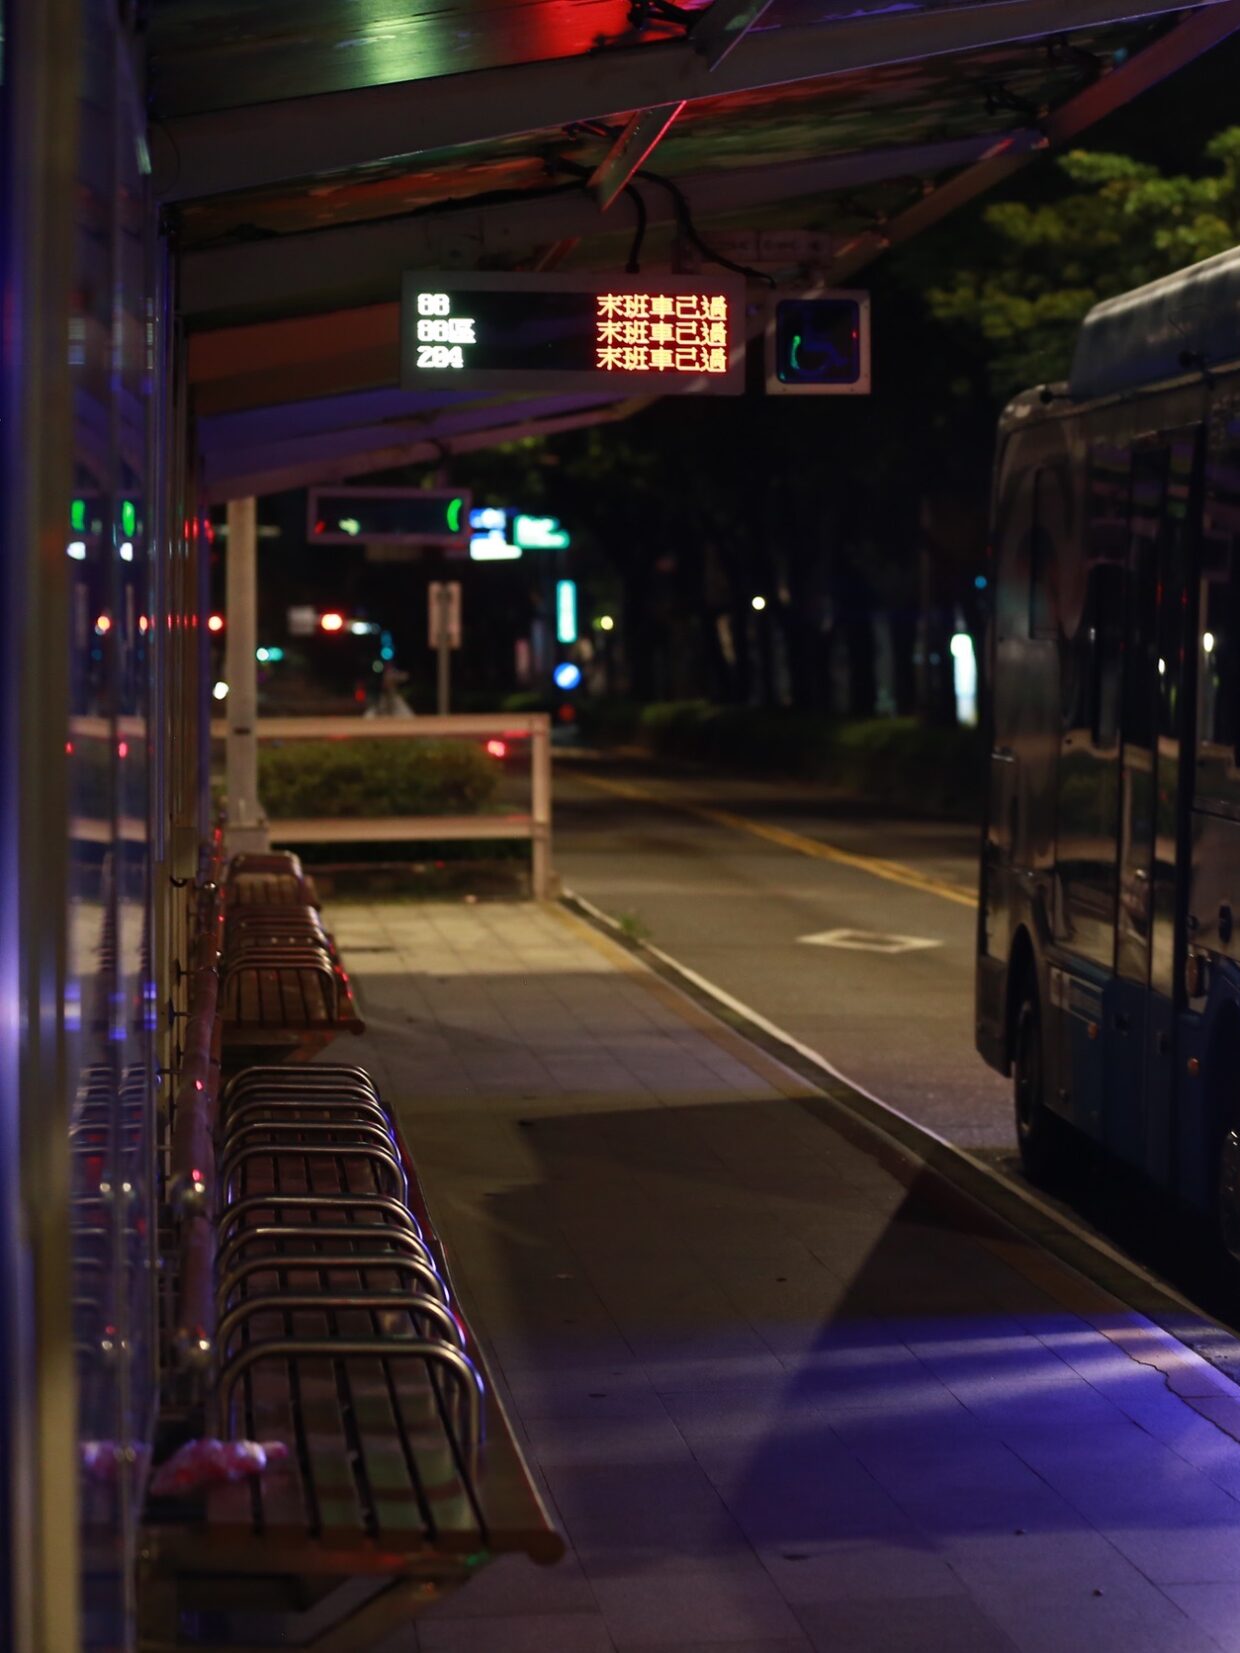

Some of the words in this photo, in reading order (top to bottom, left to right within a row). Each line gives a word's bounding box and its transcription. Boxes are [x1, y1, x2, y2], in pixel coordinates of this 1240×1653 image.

[417, 293, 450, 315] 88
[596, 293, 728, 321] 末班車已過
[596, 319, 728, 346] 末班車已過
[416, 345, 464, 368] 204
[596, 345, 728, 372] 末班車已過
